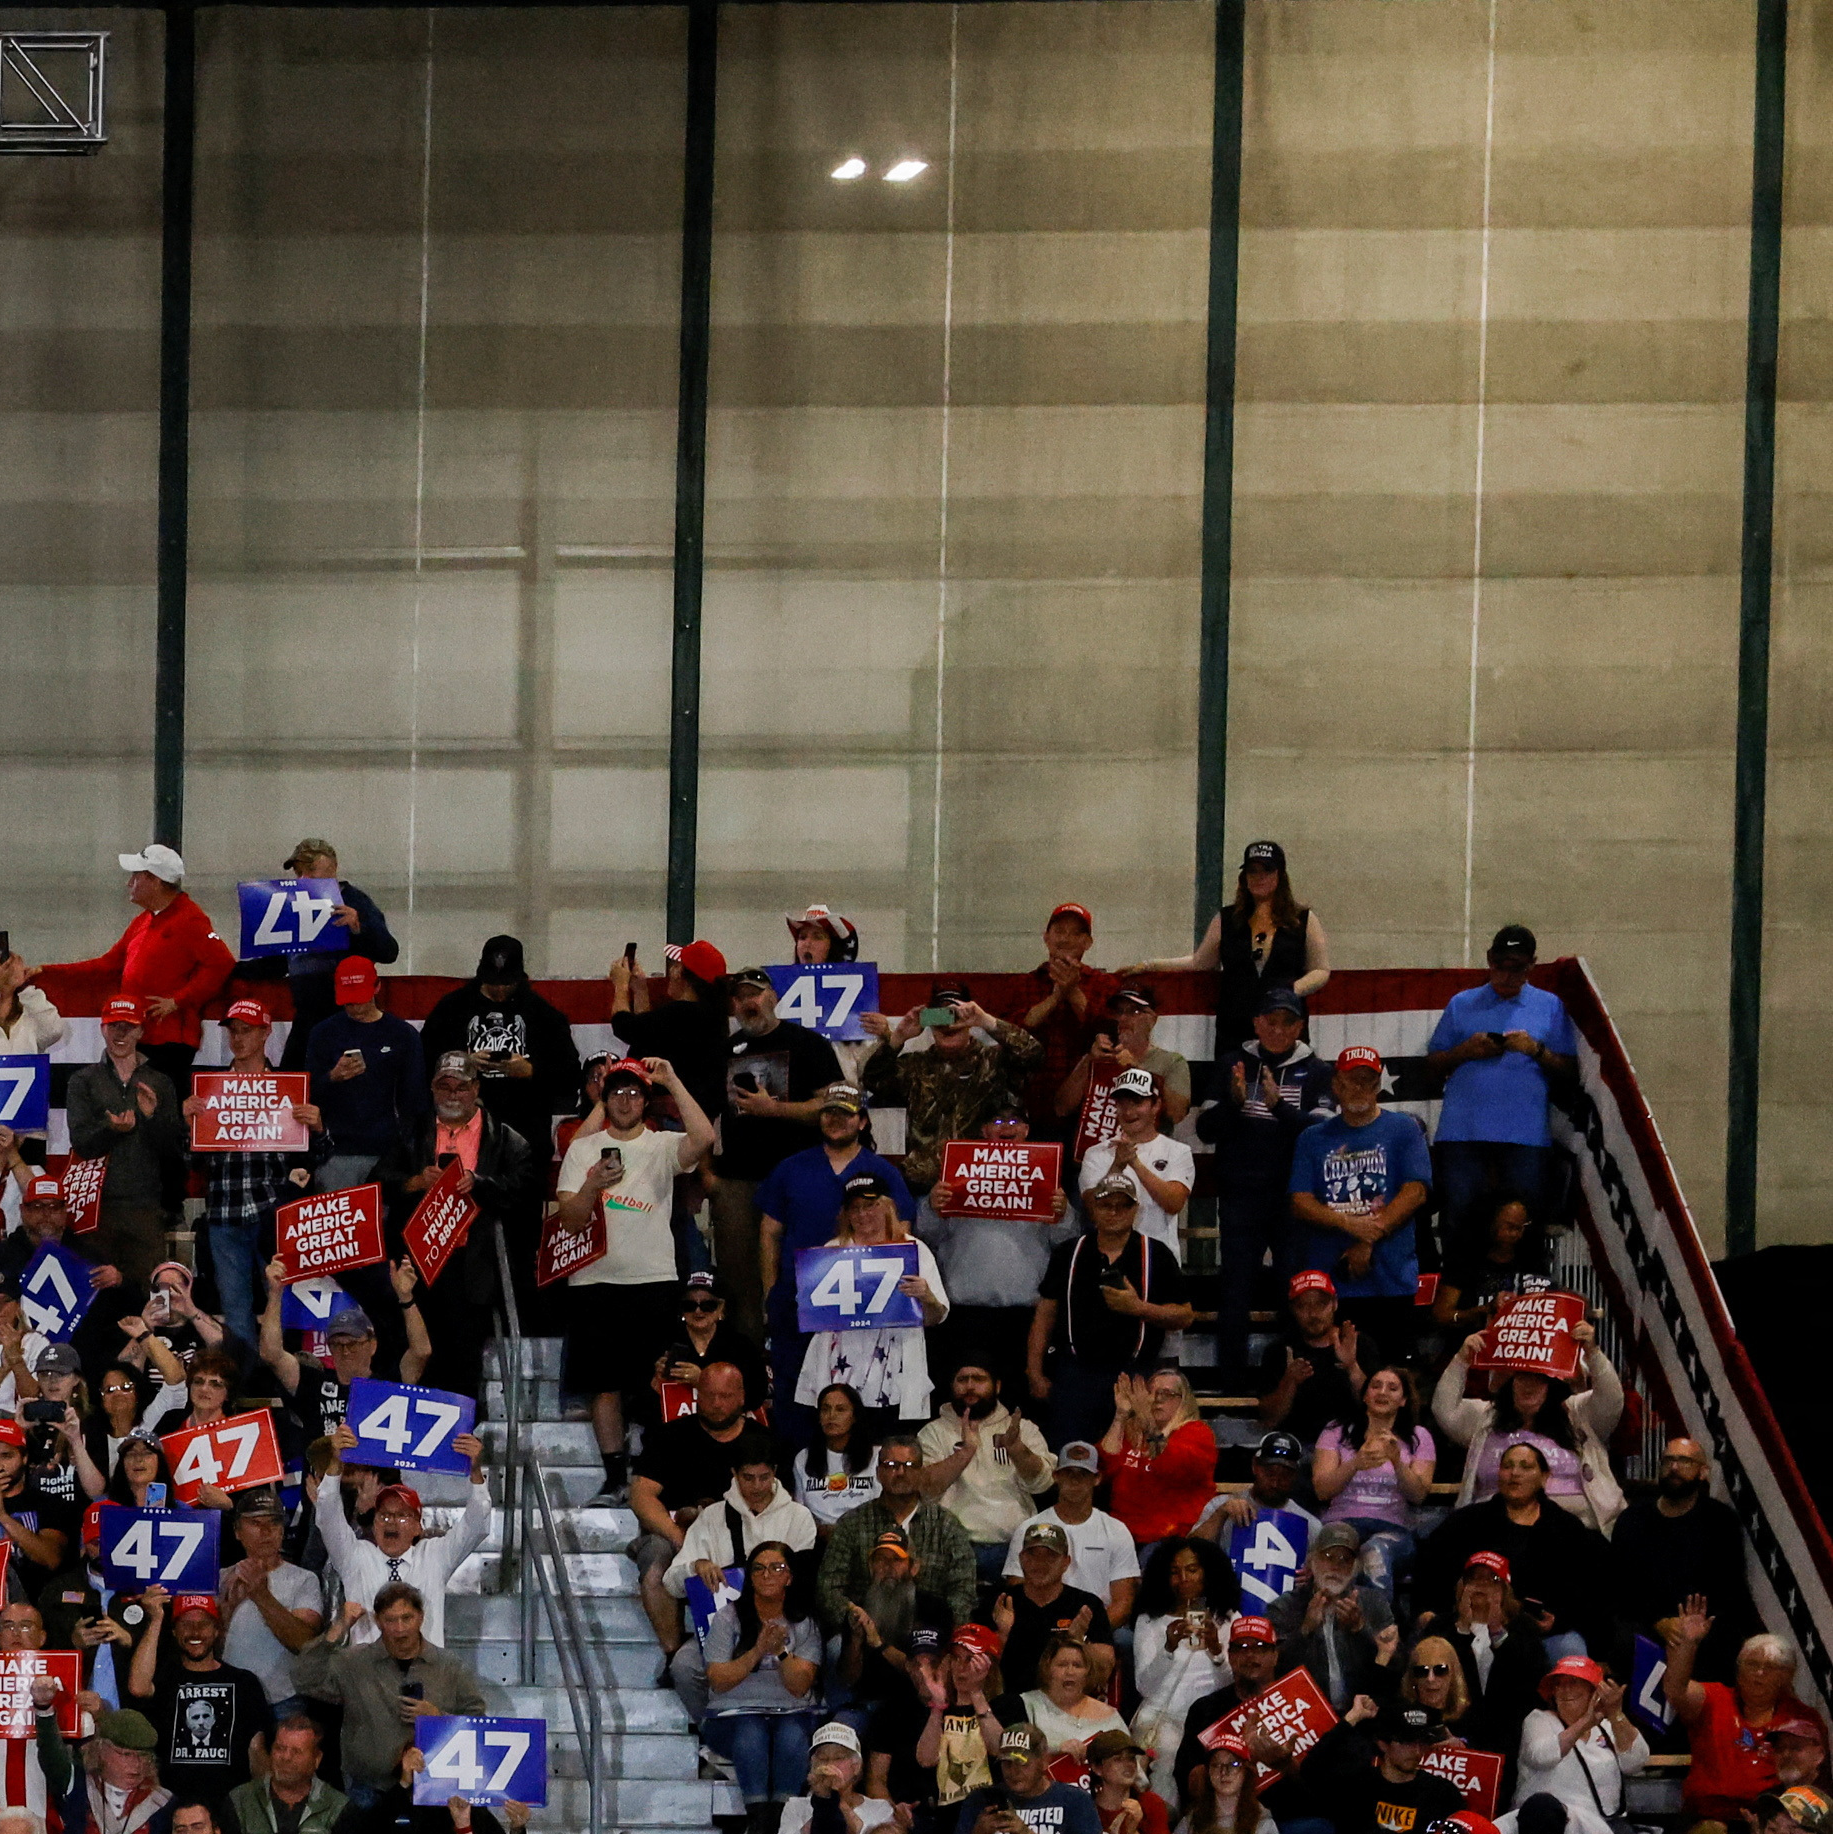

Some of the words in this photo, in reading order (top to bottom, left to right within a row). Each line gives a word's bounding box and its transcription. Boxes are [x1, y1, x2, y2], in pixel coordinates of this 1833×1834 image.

[775, 974, 865, 1028] 47
[1345, 1049, 1377, 1063] TRUMP
[222, 1080, 277, 1094] MAKE
[206, 1095, 293, 1110] AMERICA
[217, 1110, 281, 1126] GREAT
[215, 1125, 283, 1141] AGAIN!
[973, 1148, 1029, 1164] MAKE
[954, 1163, 1045, 1180] AMERICA
[965, 1179, 1034, 1196] GREAT
[298, 1196, 350, 1219] MAKE
[963, 1193, 1034, 1211] AGAIN!
[285, 1208, 367, 1240] AMERICA
[421, 1194, 455, 1246] TRUMP
[296, 1226, 356, 1253] GREAT
[298, 1241, 361, 1267] AGAIN!
[811, 1258, 905, 1316] 47
[1511, 1299, 1556, 1315] MAKE
[1493, 1313, 1569, 1333] AMERICA
[1497, 1329, 1555, 1346] GREAT
[1493, 1344, 1553, 1363] AGAIN!
[358, 1396, 462, 1457] 47
[174, 1424, 262, 1491] 47
[393, 1459, 417, 1470] 2024
[110, 1521, 205, 1580] 47
[177, 1687, 227, 1700] ARREST
[427, 1731, 530, 1791] 47
[1376, 1806, 1415, 1827] NIKE
